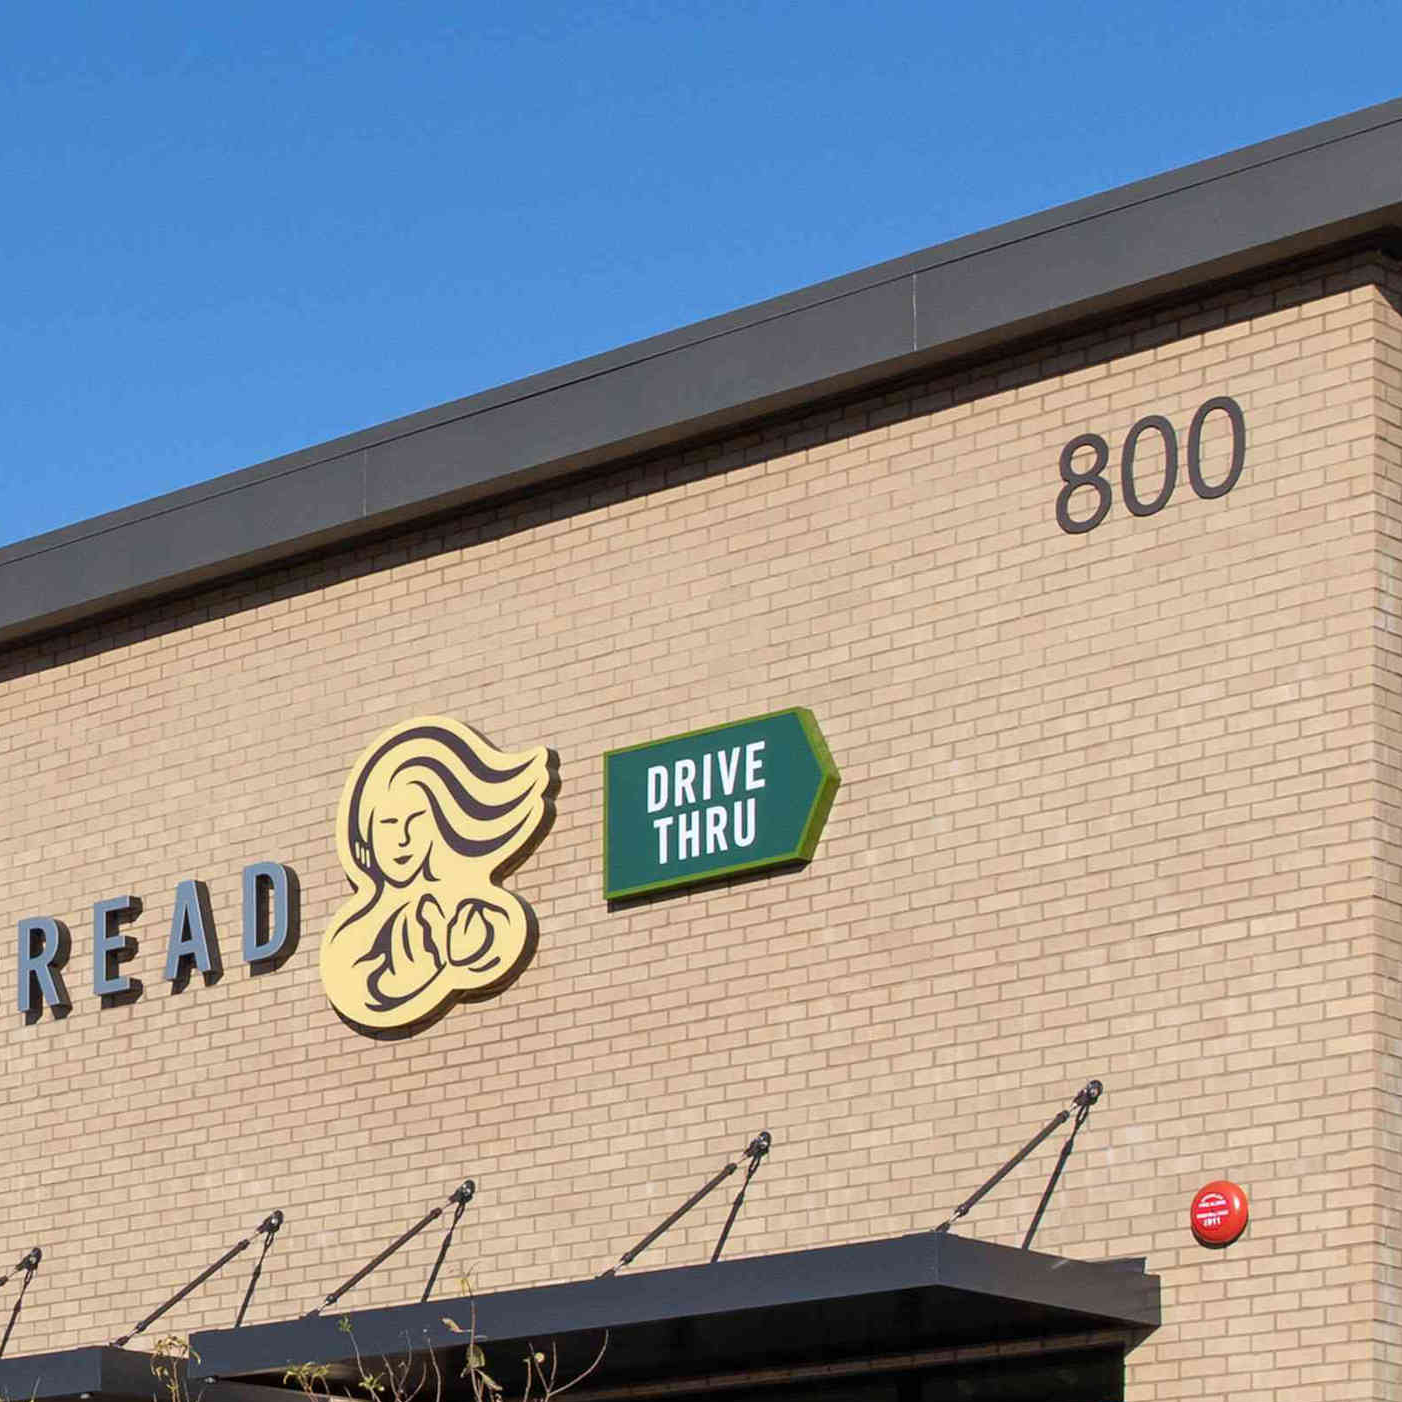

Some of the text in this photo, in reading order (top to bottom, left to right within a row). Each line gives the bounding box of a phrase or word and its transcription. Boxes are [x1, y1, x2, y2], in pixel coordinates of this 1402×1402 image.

[1055, 395, 1247, 535] 800
[647, 740, 766, 814] DRIVE
[652, 797, 757, 865] THRU
